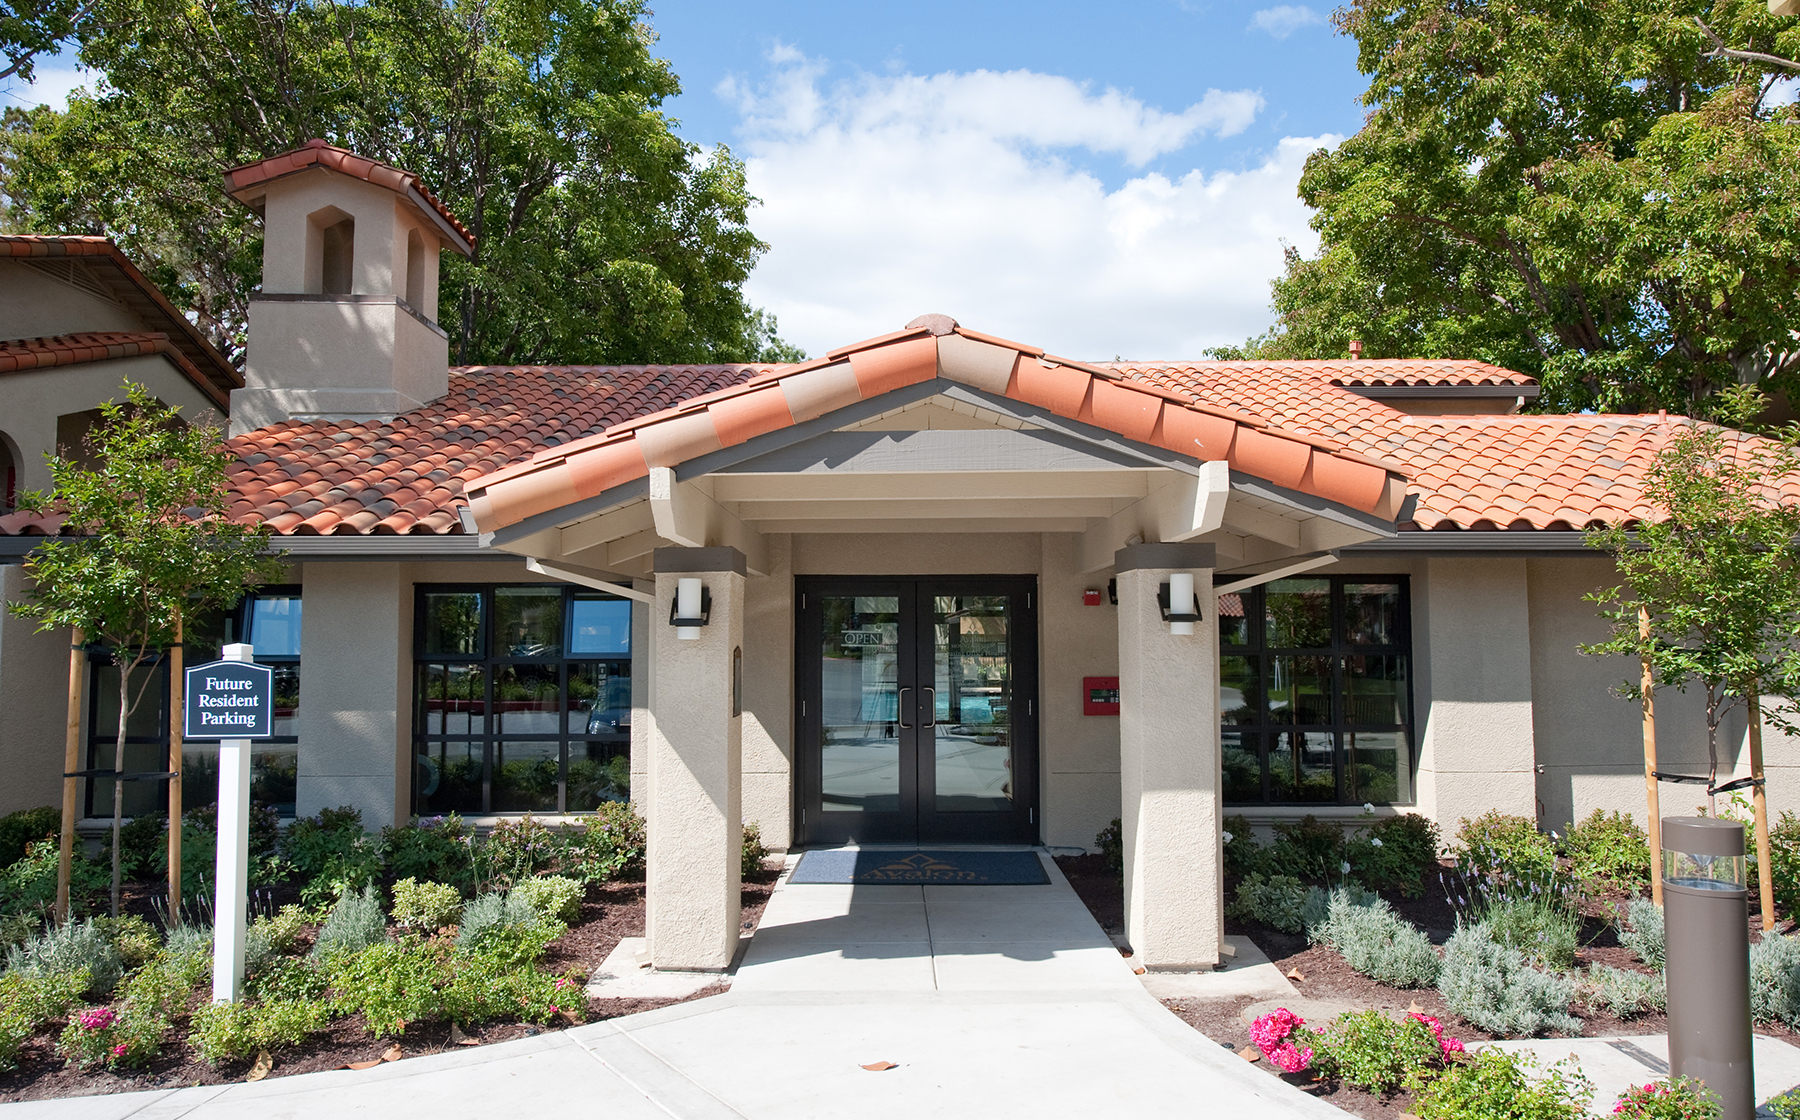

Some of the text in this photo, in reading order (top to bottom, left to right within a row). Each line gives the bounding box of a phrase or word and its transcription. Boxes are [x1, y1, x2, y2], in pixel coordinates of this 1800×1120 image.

[844, 633, 880, 644] OPEN
[206, 677, 253, 690] Future
[198, 694, 259, 707] Resident
[201, 712, 256, 728] Parking
[863, 869, 977, 877] Avalon
